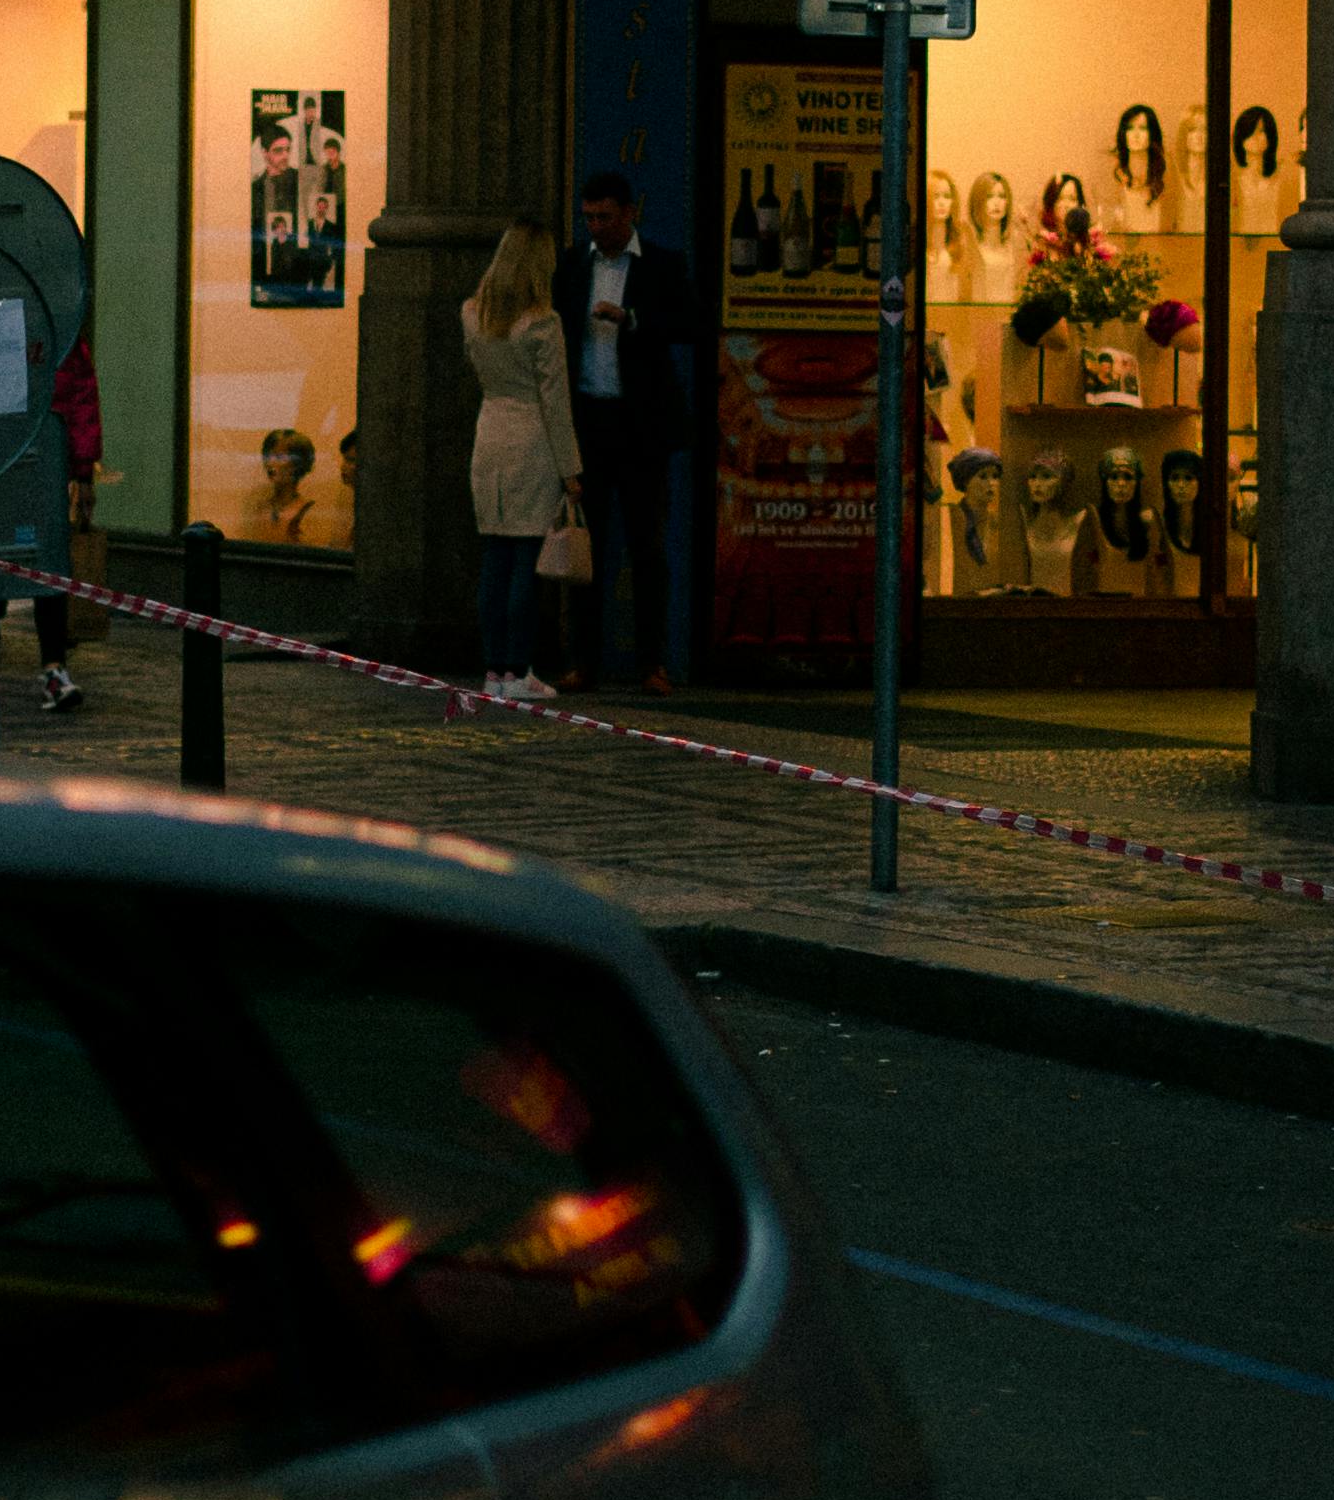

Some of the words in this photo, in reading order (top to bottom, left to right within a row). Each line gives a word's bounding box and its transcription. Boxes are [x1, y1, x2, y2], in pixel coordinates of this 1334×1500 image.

[795, 90, 884, 112] VINOTE
[795, 116, 849, 135] WINE
[753, 501, 809, 521] 1909
